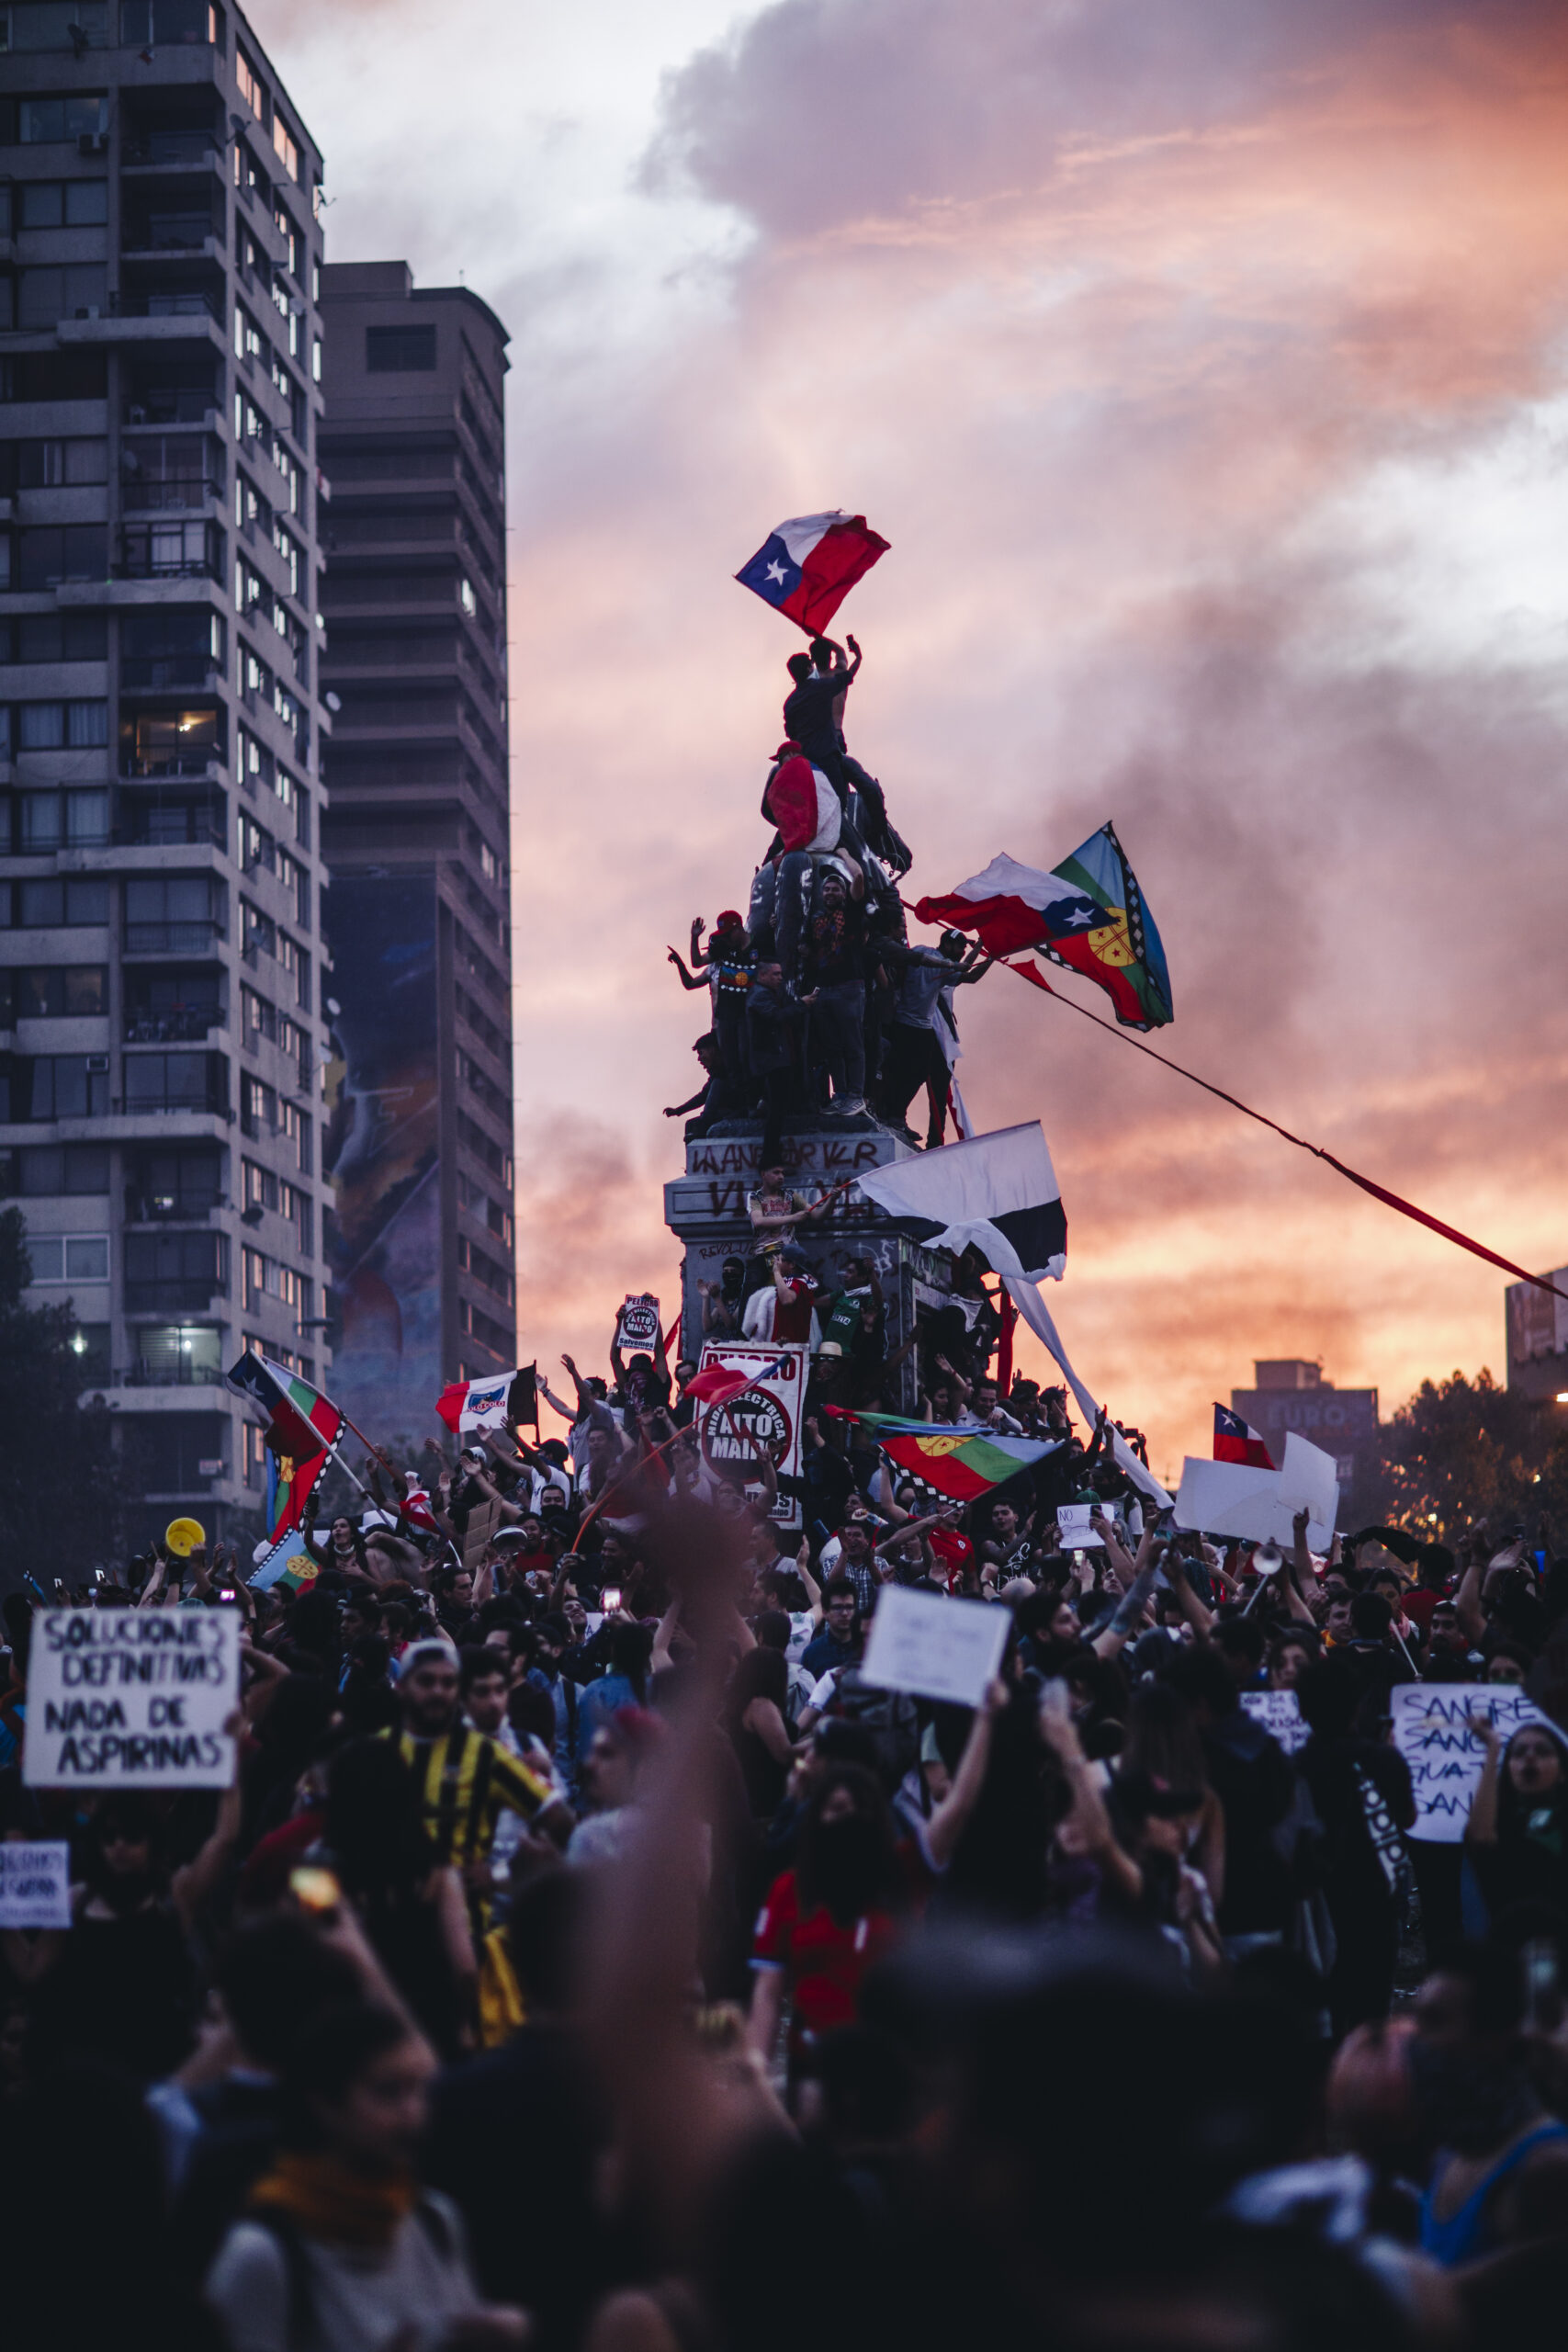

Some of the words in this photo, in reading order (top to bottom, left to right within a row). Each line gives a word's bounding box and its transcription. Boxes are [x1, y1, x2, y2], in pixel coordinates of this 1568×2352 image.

[619, 1338, 654, 1348] Salvemos
[711, 1436, 779, 1461] MAIP
[770, 1508, 789, 1517] aipo
[1059, 1510, 1073, 1521] NO
[44, 1614, 226, 1653] SOLUCIONES
[62, 1651, 227, 1688] DEFINITIVAS
[44, 1697, 126, 1734] NADA
[149, 1695, 186, 1728] DE
[57, 1733, 220, 1775] ASPIRINAS
